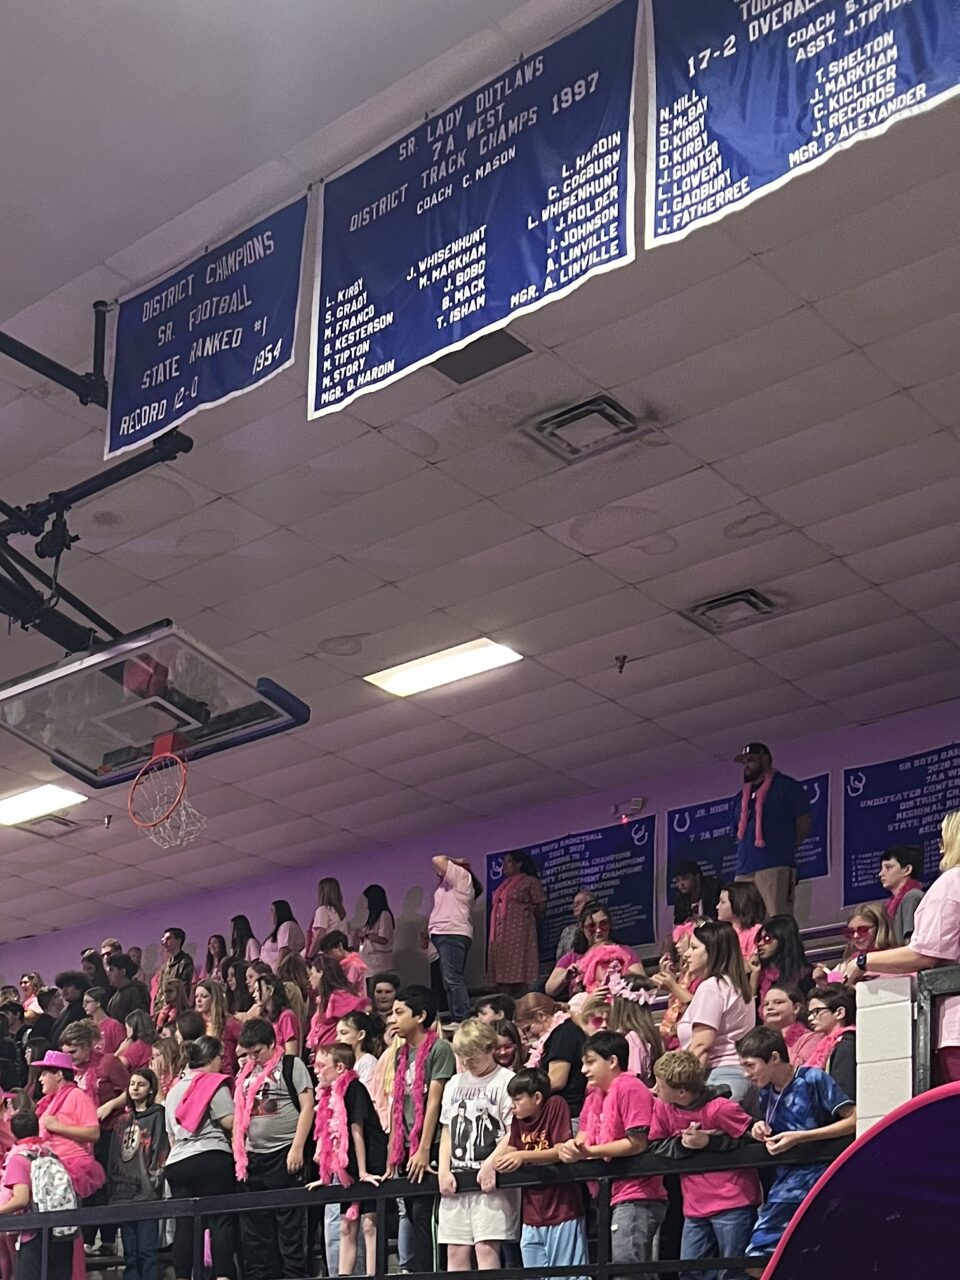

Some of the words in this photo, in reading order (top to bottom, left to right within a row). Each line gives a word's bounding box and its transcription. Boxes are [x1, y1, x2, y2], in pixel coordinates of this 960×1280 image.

[688, 35, 736, 77] 17-2
[749, 0, 823, 42] OVERAL
[788, 10, 836, 48] COACH
[796, 29, 836, 63] ASST.
[843, 19, 859, 36] J.
[858, 0, 913, 28] TIPTO
[810, 88, 823, 104] J.
[825, 45, 898, 97] MARKHAM
[816, 67, 826, 83] T.
[828, 30, 894, 78] SHELTON
[398, 139, 418, 161] SR.
[426, 106, 464, 144] LADY
[476, 55, 544, 114] OUTLAWS
[659, 108, 673, 122] N.
[674, 89, 699, 115] HILL
[812, 121, 826, 137] J.
[829, 82, 896, 129] RECORDS
[814, 103, 827, 119] C.
[829, 64, 897, 113] KICLITER
[466, 102, 506, 139] WEST
[659, 124, 673, 137] S.
[659, 138, 673, 153] D.
[673, 115, 705, 148] KIRBY
[789, 140, 822, 168] MGR.
[824, 131, 836, 149] P.
[838, 83, 927, 141] ALEXANDER
[349, 183, 409, 232] DISTRICT
[420, 150, 467, 190] TRACK
[479, 106, 539, 156] CHAMPS
[551, 71, 600, 115] 1997
[562, 164, 573, 178] L.
[576, 131, 621, 171] HARDIN
[658, 170, 671, 185] J.
[672, 140, 719, 180] GUNTER
[659, 154, 673, 169] D.
[673, 131, 708, 164] KIRBY
[416, 183, 453, 216] COACH
[462, 174, 473, 189] C.
[475, 145, 517, 183] MASON
[527, 216, 539, 230] L.
[541, 167, 619, 222] WHISENHUNT
[548, 186, 560, 200] C.
[563, 149, 621, 194] COGBURN
[657, 186, 672, 200] L.
[673, 155, 723, 196] LOWERY
[657, 202, 671, 217] J.
[672, 168, 732, 212] GADBURY
[547, 239, 558, 254] J.
[560, 204, 619, 247] JOHNSON
[555, 217, 566, 232] J.
[568, 185, 619, 225] HOLDER
[657, 219, 671, 234] J.
[673, 176, 751, 230] FATHERREE
[406, 266, 417, 281] J.
[418, 225, 487, 273] WHISENHUNT
[419, 275, 430, 290] M.
[432, 242, 486, 283] MARKHAM
[546, 257, 559, 274] A.
[560, 222, 619, 266] LINVILLE
[143, 274, 194, 322] DISTRICT
[206, 231, 274, 285] CHAMPIONS
[326, 295, 335, 308] L.
[338, 277, 364, 302] KIRBY
[441, 295, 452, 311] B.
[454, 277, 486, 301] MACK
[443, 278, 454, 293] J.
[455, 260, 486, 286] BOBO
[510, 284, 539, 309] MGR.
[544, 276, 557, 293] A.
[560, 240, 619, 284] LINVILLE
[158, 321, 176, 346] SR.
[189, 284, 252, 332] FOOTBALL
[324, 326, 334, 340] M.
[336, 305, 375, 335] FRANCO
[325, 311, 334, 324] S.
[336, 291, 368, 318] GRADY
[436, 316, 447, 330] T.
[449, 294, 486, 323] ISHAM
[141, 355, 180, 389] STATE
[189, 327, 243, 364] RANKED
[254, 316, 267, 336] #1
[323, 359, 332, 373] M.
[334, 340, 370, 367] TIPTON
[324, 343, 333, 357] B.
[335, 312, 394, 351] KESTERSON
[119, 399, 166, 435] RECORD
[173, 376, 198, 410] 12-0
[252, 338, 282, 375] 1954
[320, 387, 344, 404] MGR.
[346, 378, 356, 392] D.
[357, 359, 395, 387] HARDIN
[322, 375, 333, 389] M.
[333, 357, 366, 383] STORY
[900, 792, 944, 810] DISTRICT
